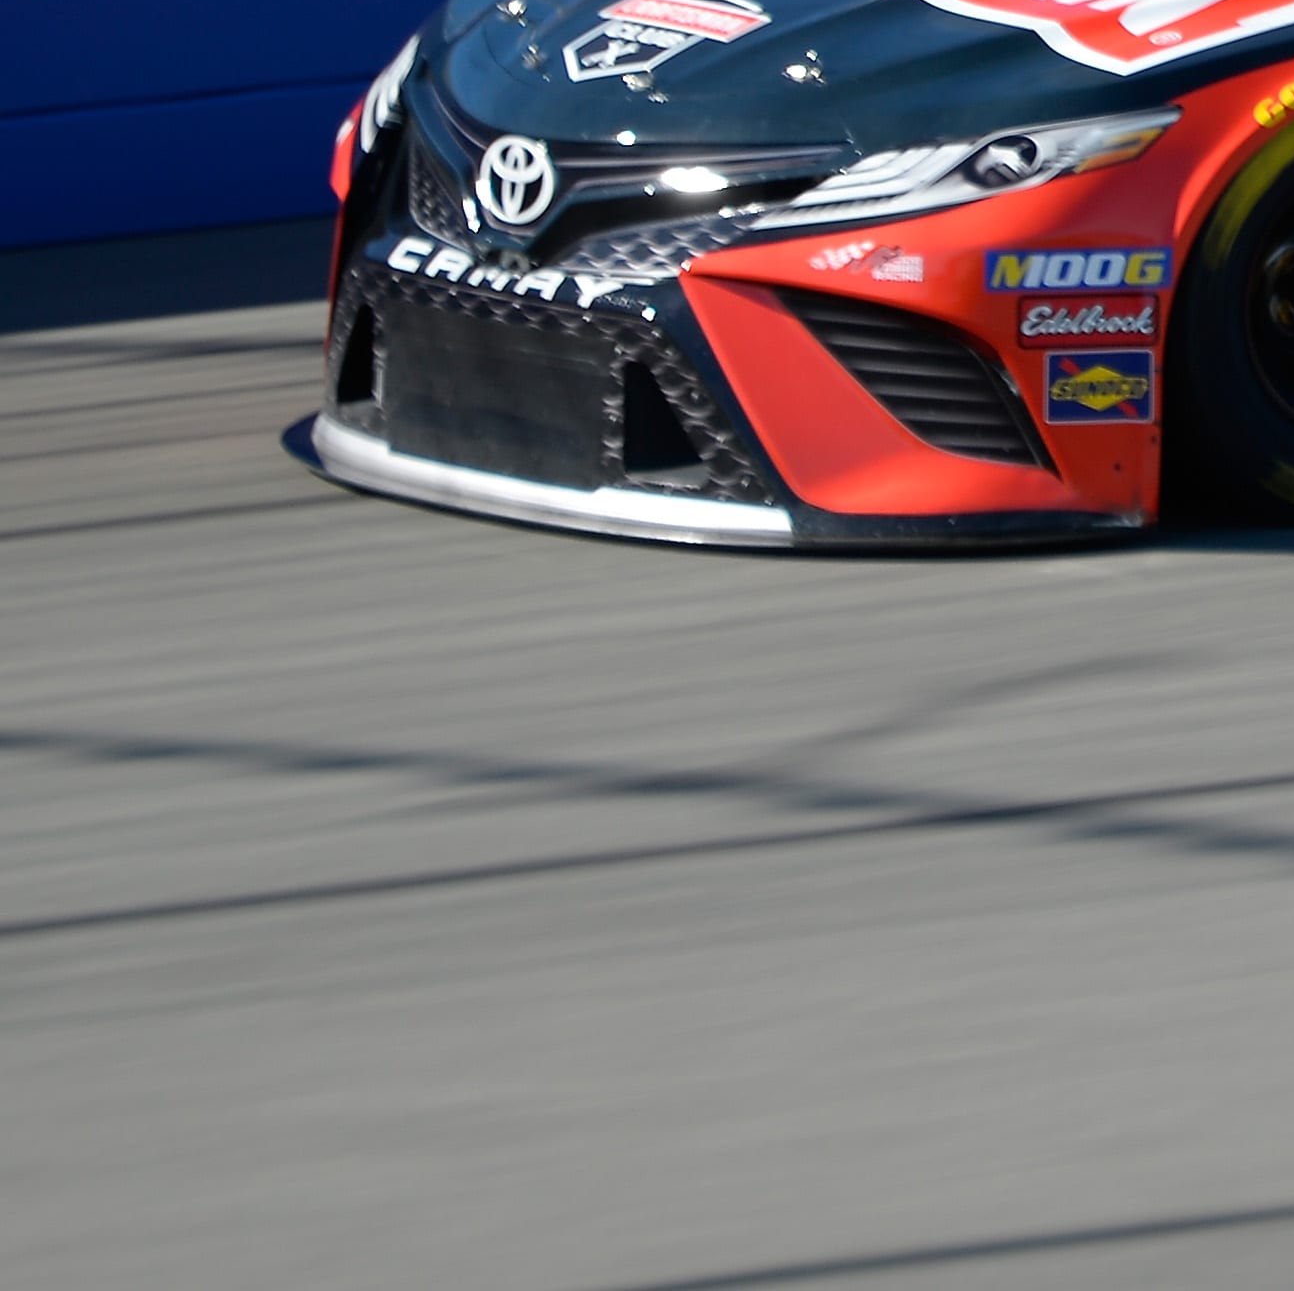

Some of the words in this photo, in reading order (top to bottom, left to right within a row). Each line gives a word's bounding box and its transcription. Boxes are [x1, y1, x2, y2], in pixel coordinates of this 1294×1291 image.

[991, 252, 1166, 289] MOOG
[1020, 305, 1154, 336] Edelbrock
[1050, 375, 1149, 401] SUNOCO
